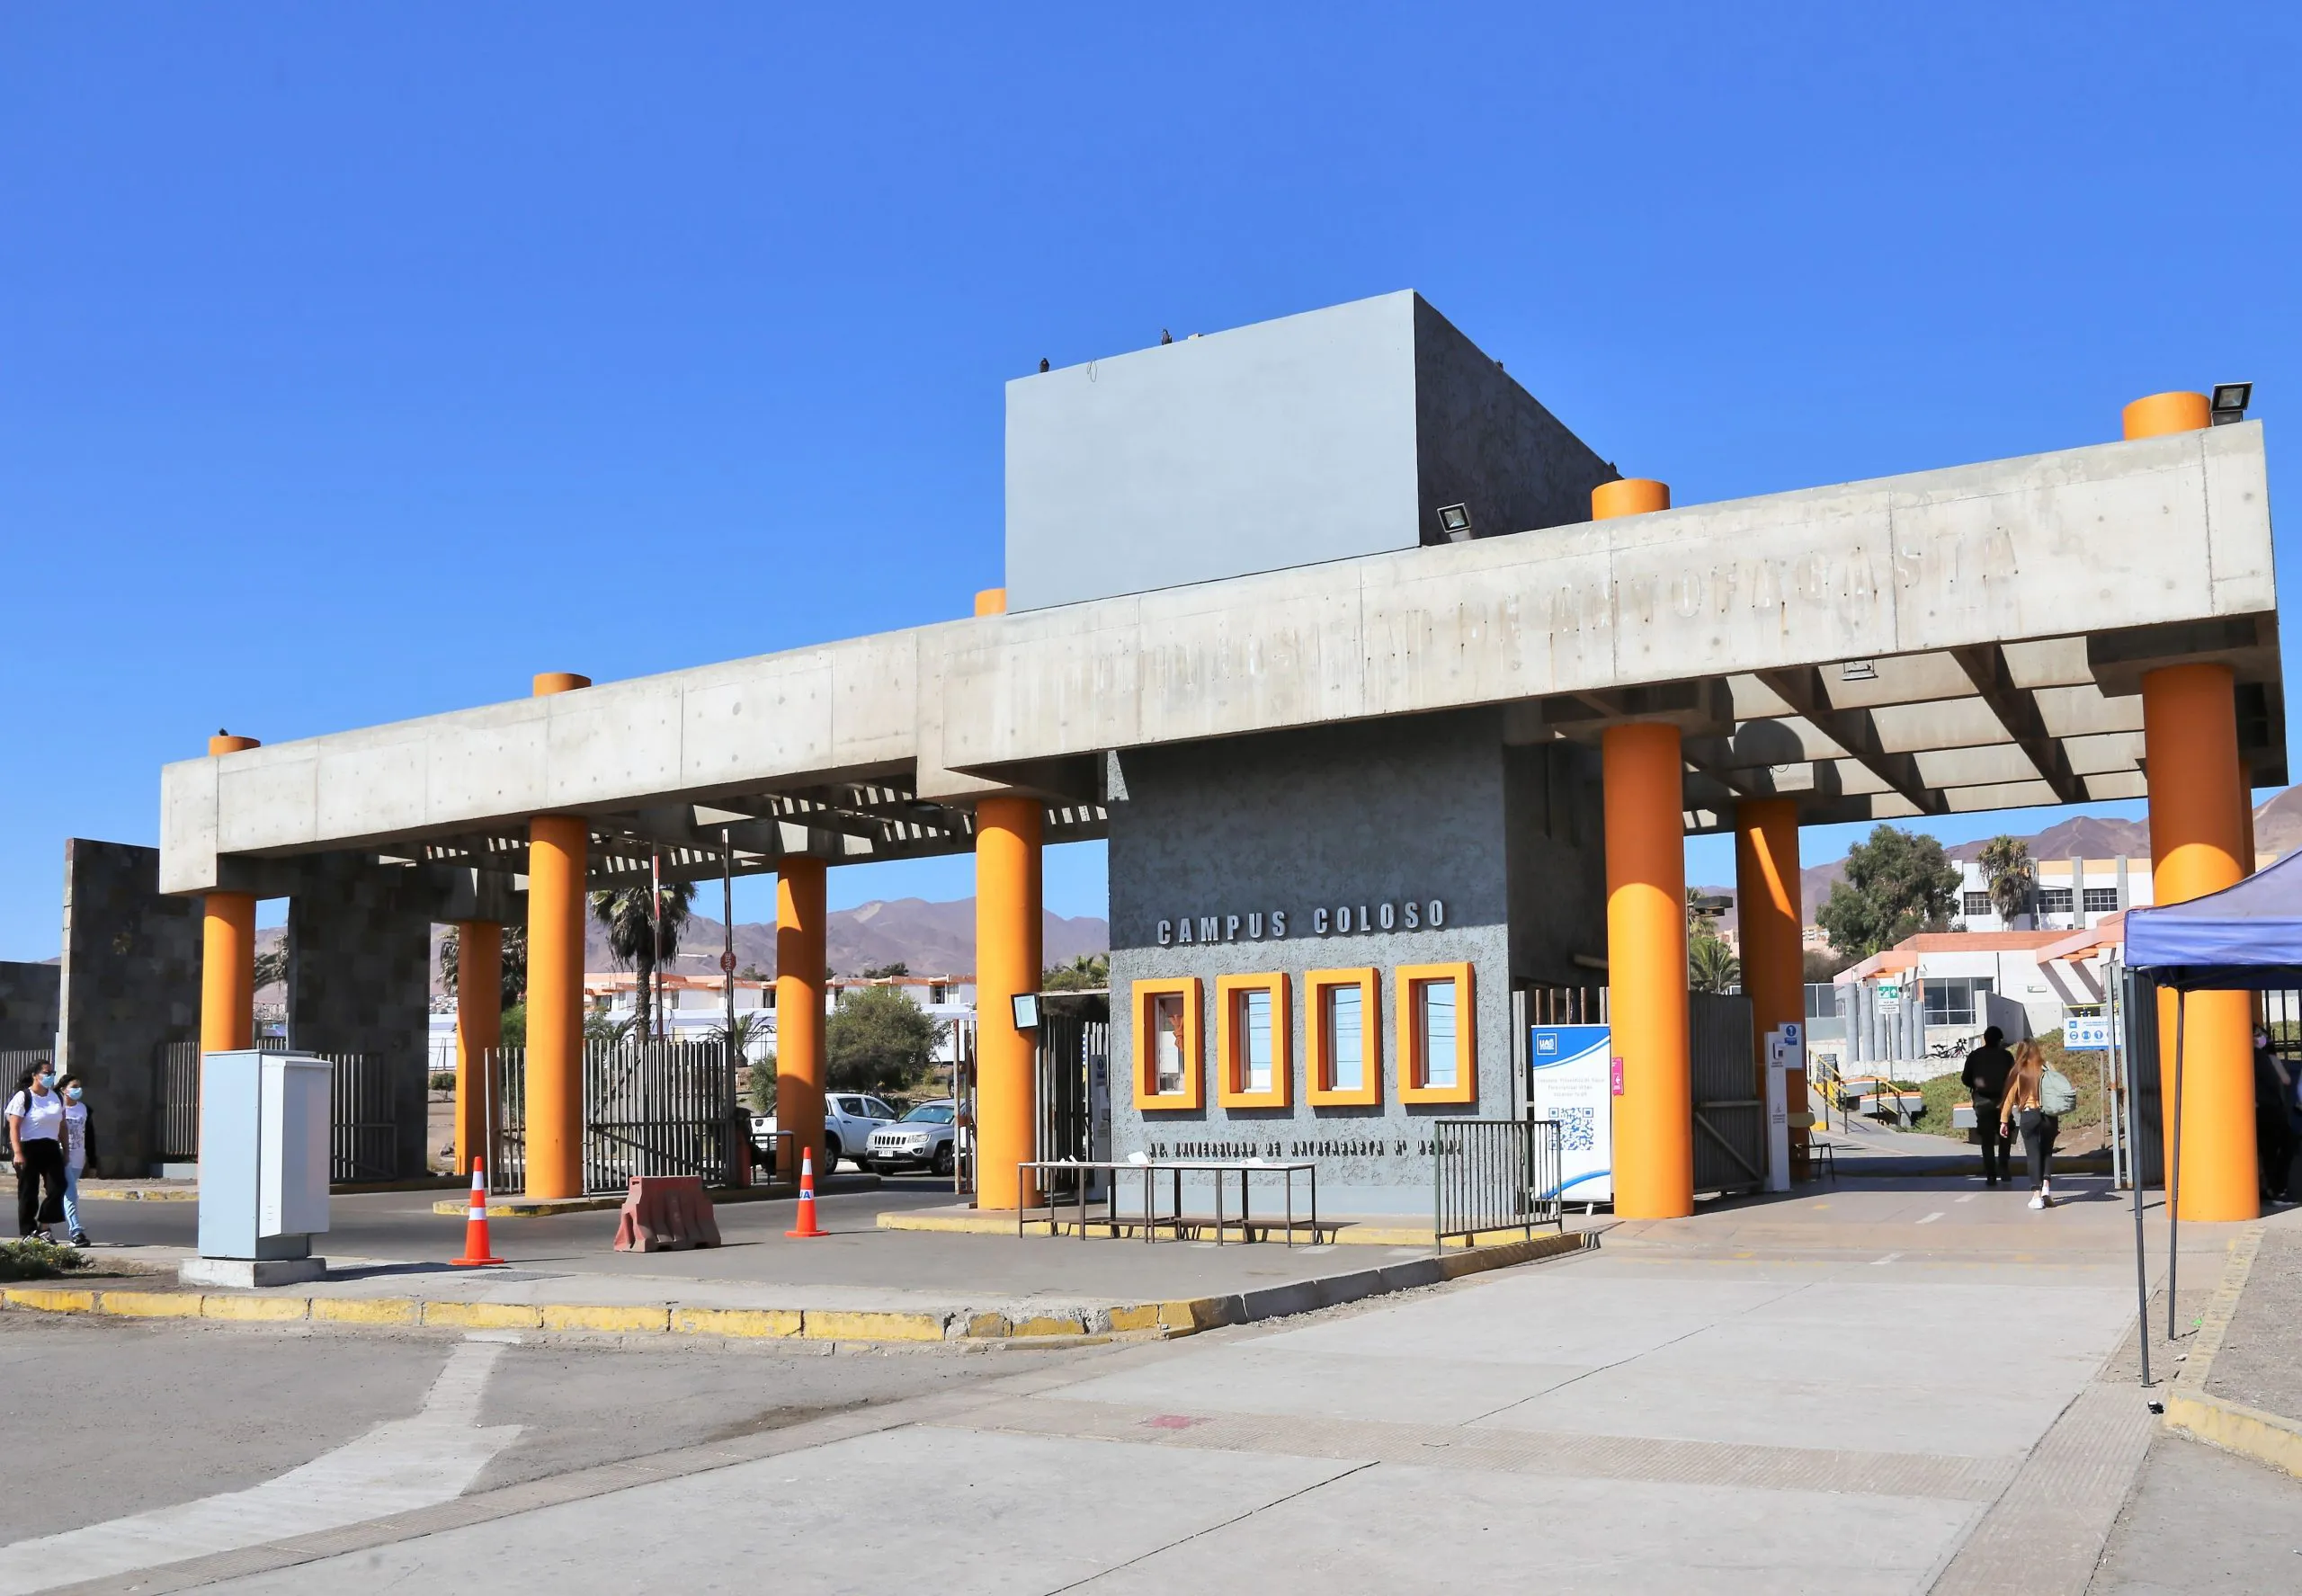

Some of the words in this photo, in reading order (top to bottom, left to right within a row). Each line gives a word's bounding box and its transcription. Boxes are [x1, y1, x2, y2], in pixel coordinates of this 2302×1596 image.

[1157, 911, 1288, 945] CAMPUS
[1314, 899, 1446, 934] COLOSO
[1173, 1141, 1256, 1157] UNIVERSIDAD
[1263, 1140, 1281, 1156] DE
[1290, 1140, 1385, 1156] ANTOFAGASTA
